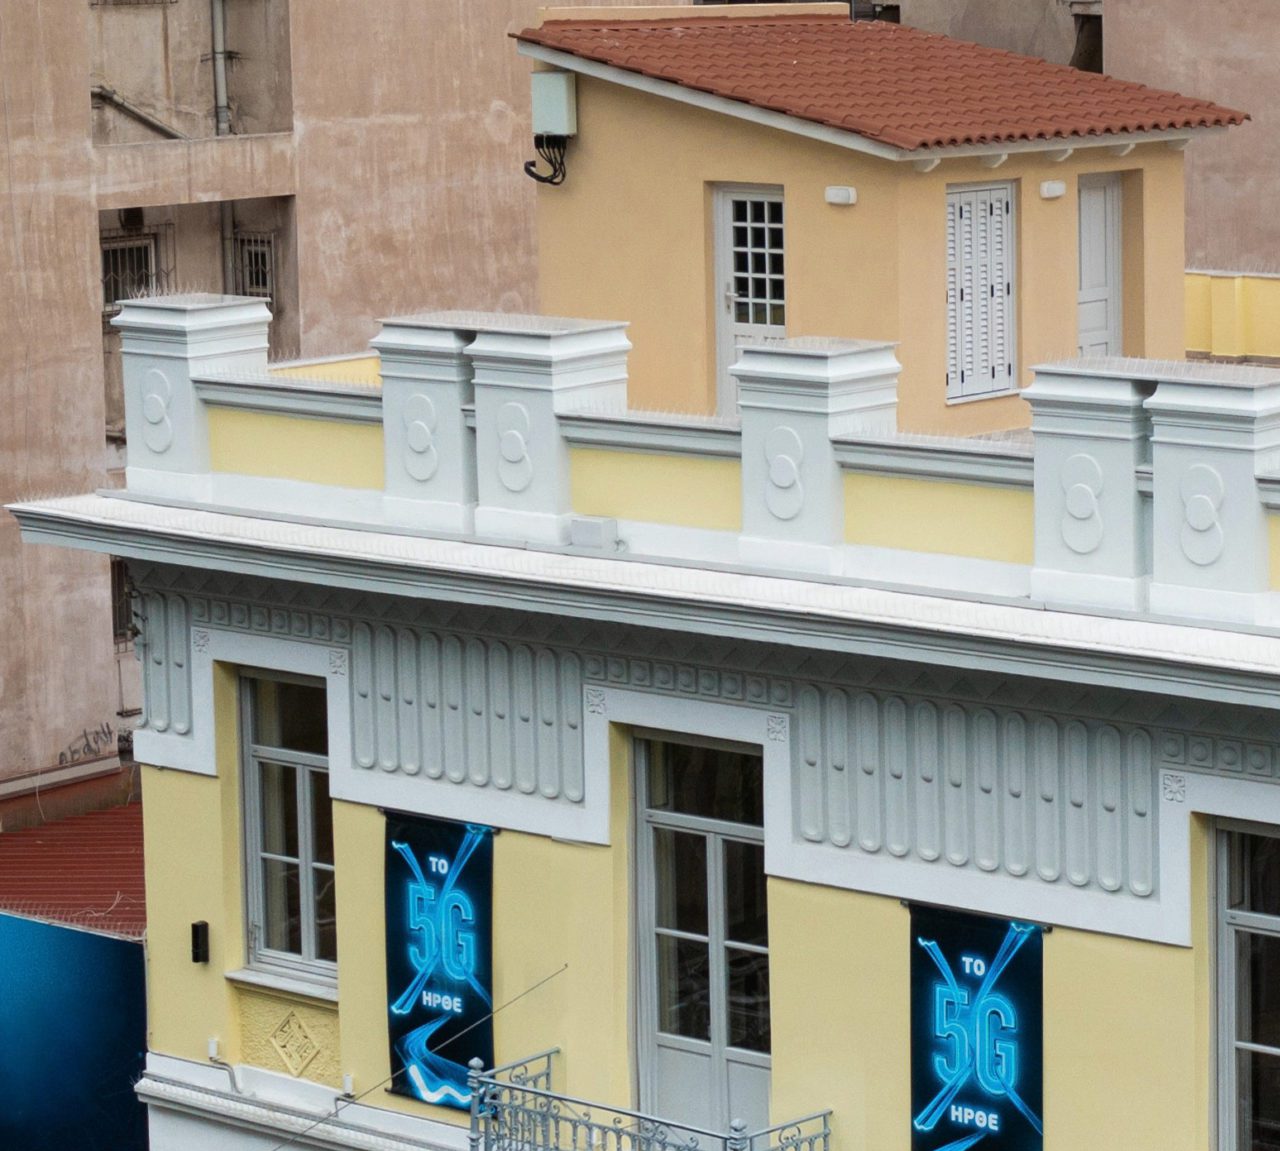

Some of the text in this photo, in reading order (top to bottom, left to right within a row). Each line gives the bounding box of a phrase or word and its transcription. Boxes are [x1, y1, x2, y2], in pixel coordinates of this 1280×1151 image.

[428, 857, 449, 875] ΤΟ
[407, 881, 475, 981] 5G
[962, 956, 985, 977] ΤΟ
[422, 990, 462, 1013] ΗΡΘΕ
[932, 984, 1017, 1096] 5G
[950, 1104, 999, 1131] ΗΡΘΕ
